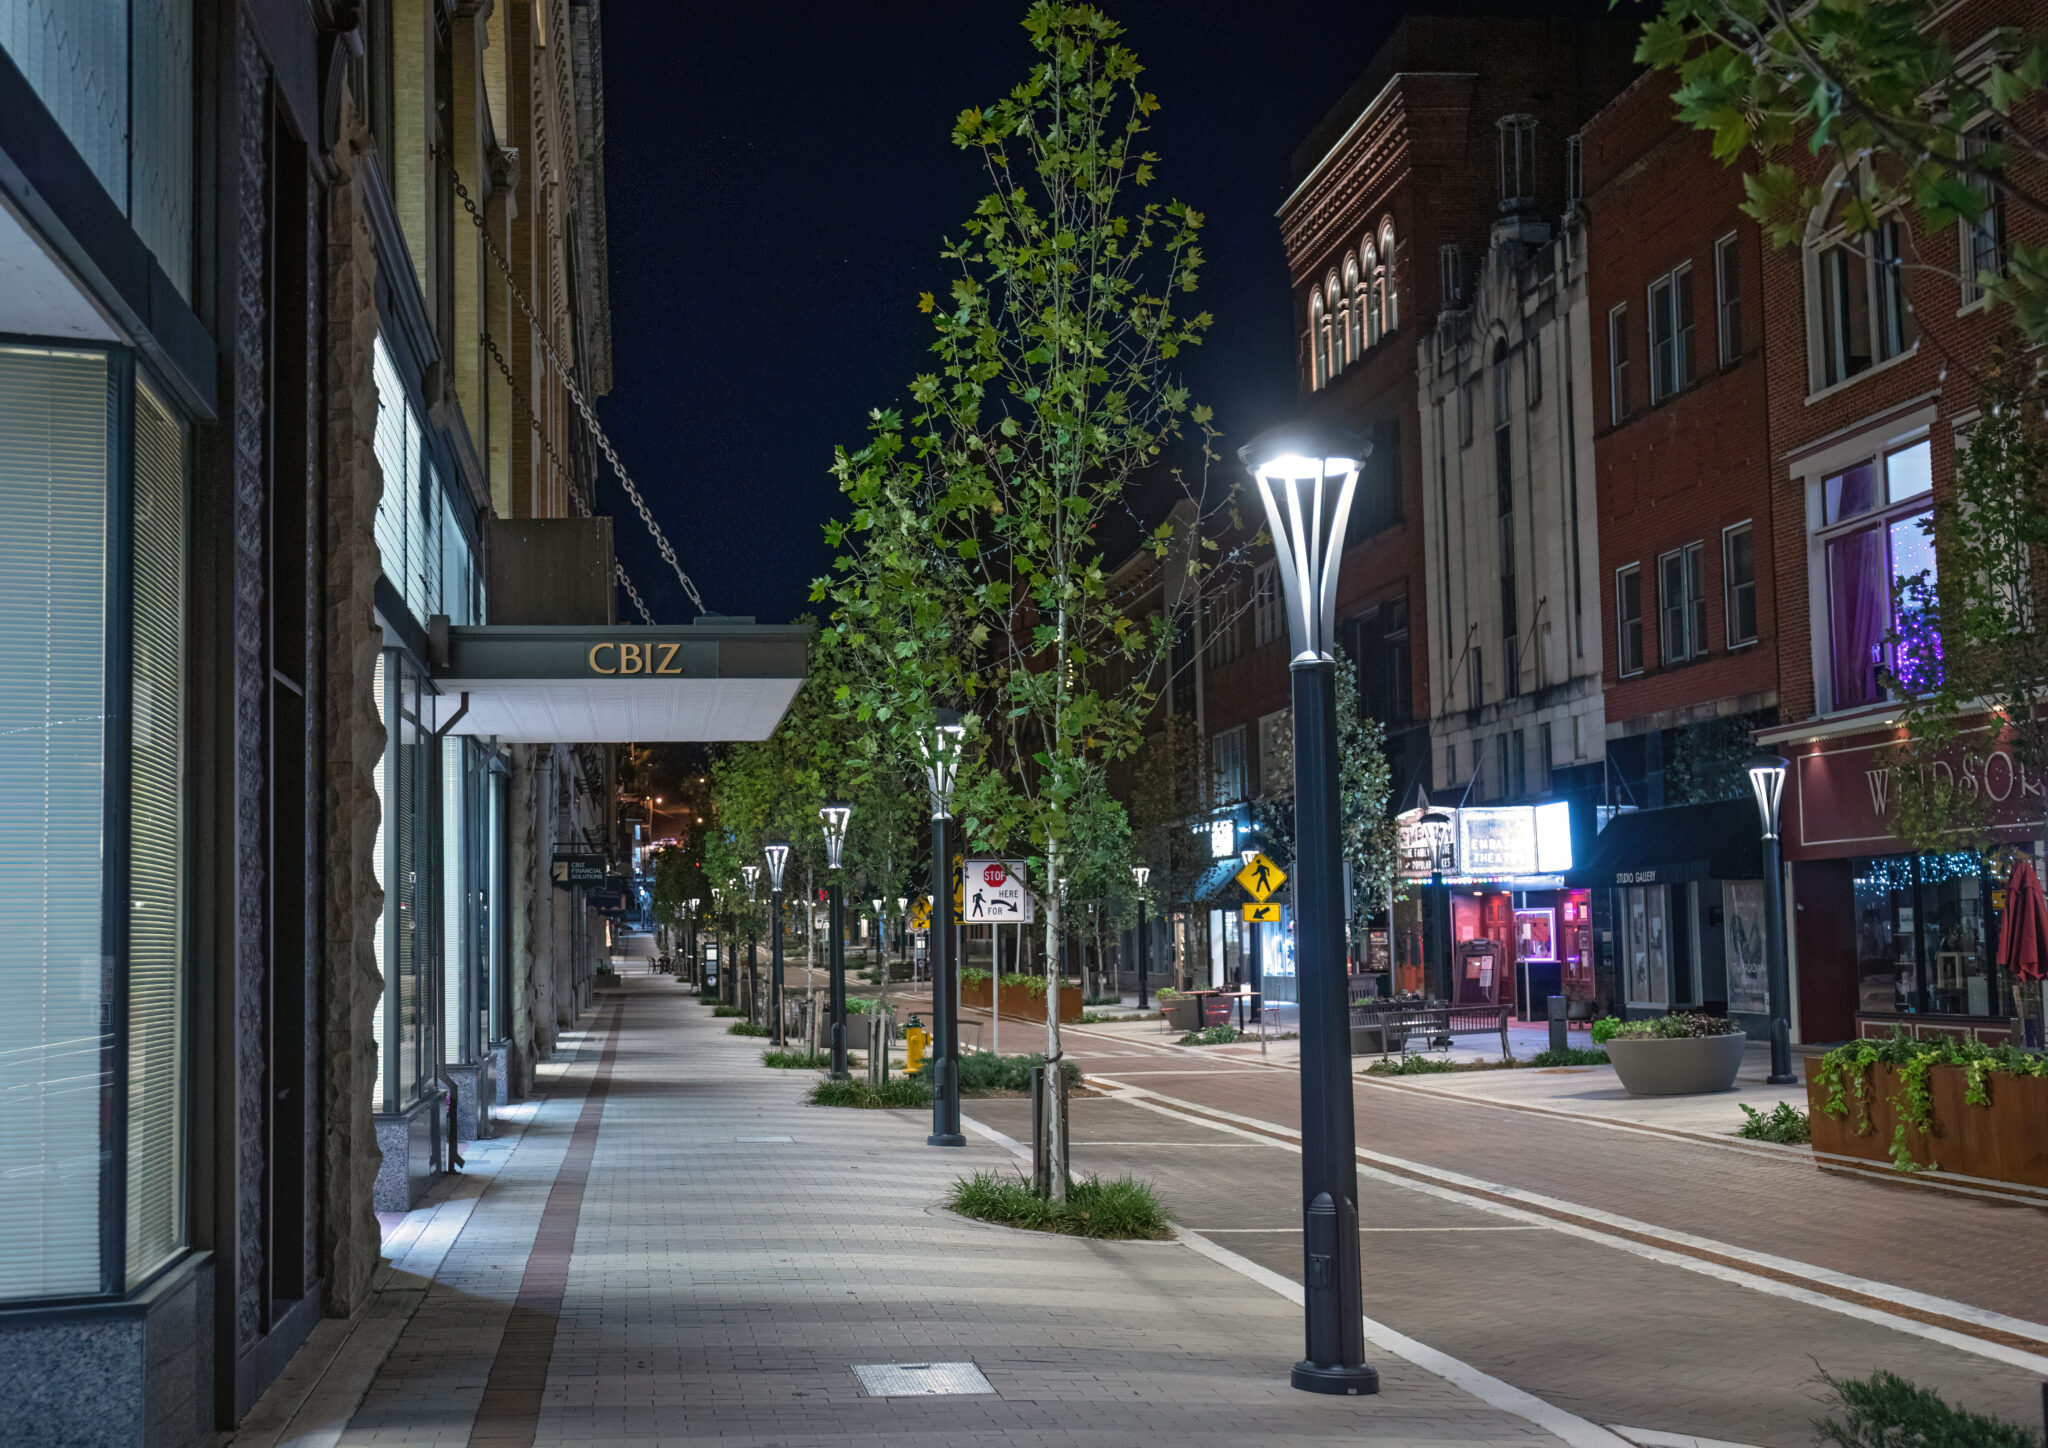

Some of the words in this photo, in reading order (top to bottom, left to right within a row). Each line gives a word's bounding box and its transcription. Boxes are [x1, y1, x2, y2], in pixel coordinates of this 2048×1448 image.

[589, 643, 682, 674] CBIZ
[1865, 751, 2041, 816] WIDSOR
[984, 870, 1006, 881] STOP
[1616, 872, 1634, 884] STUDIO
[1635, 870, 1656, 883] GALLERY
[998, 889, 1019, 898] HERE
[987, 906, 1003, 916] FOR
